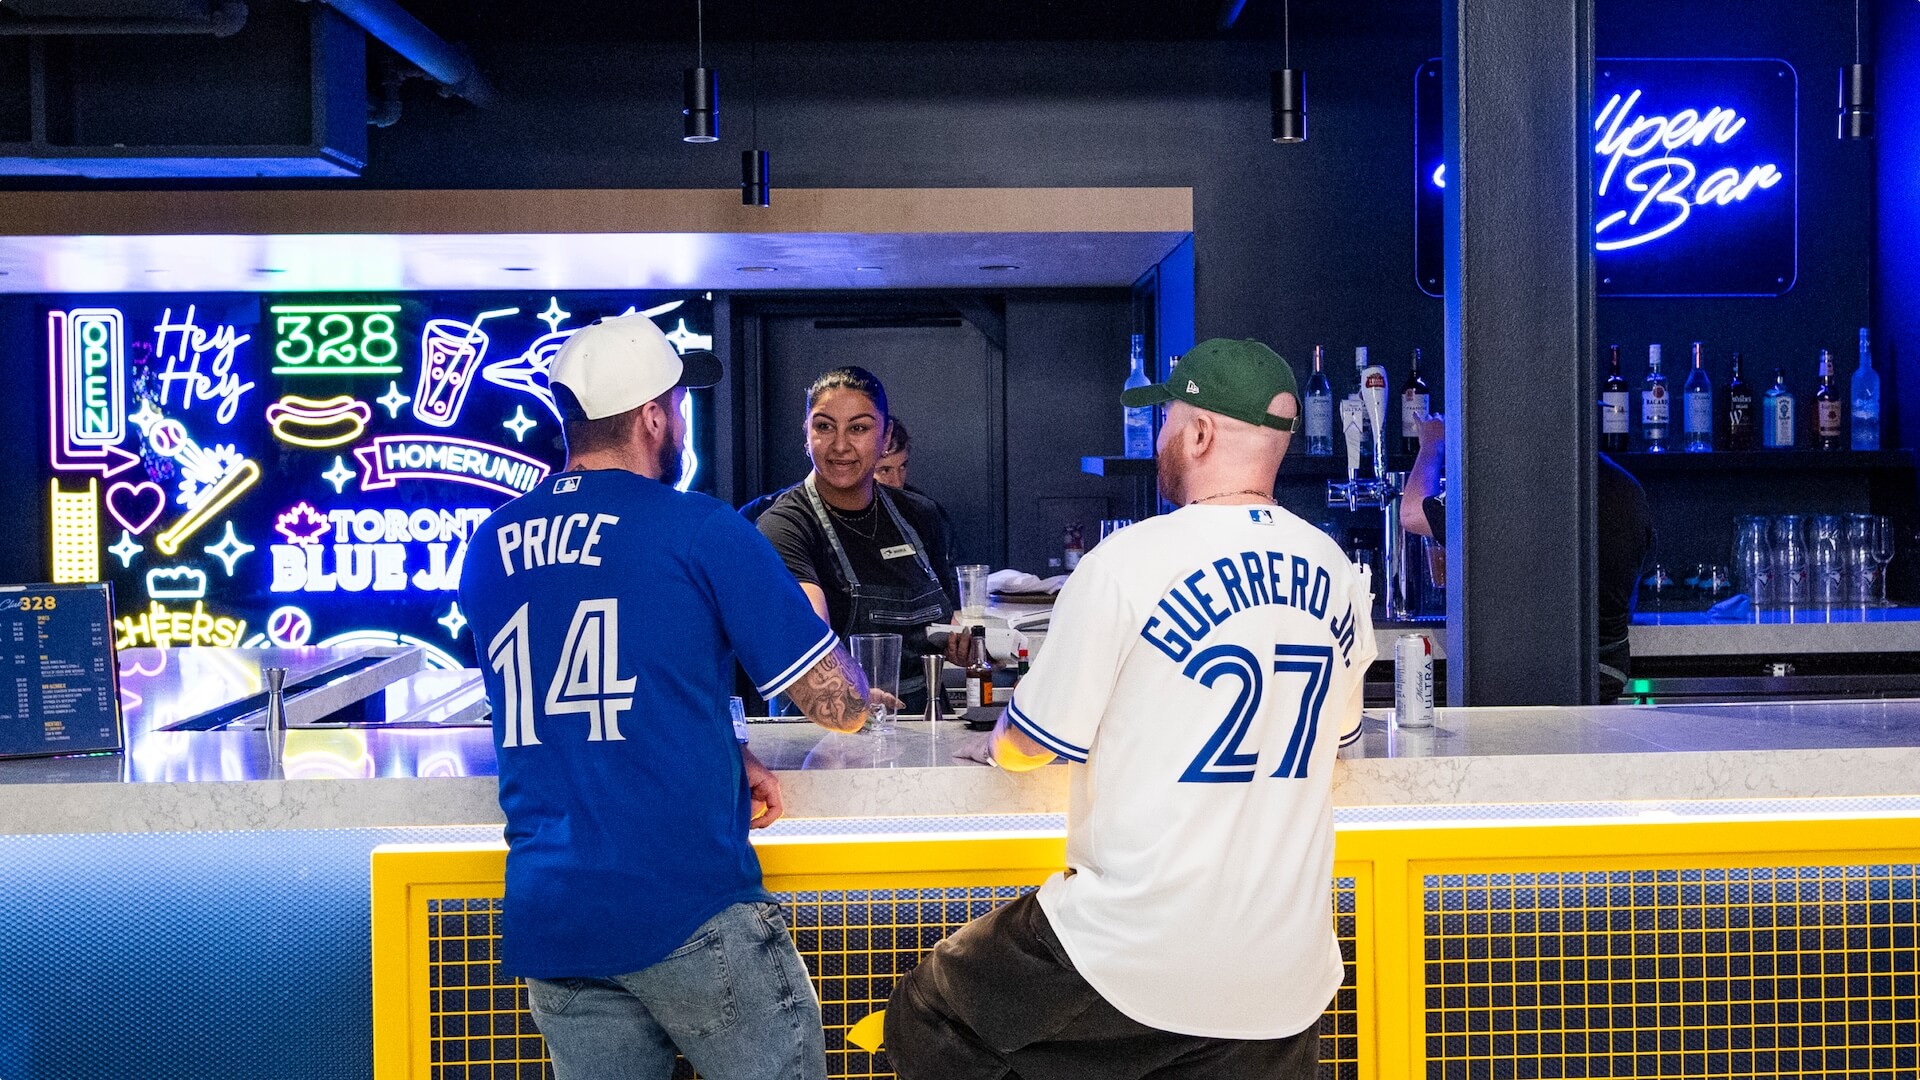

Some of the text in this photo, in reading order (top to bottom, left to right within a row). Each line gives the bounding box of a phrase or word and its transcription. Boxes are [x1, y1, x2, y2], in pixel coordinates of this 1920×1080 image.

[1596, 156, 1783, 251] Bar
[153, 304, 251, 377] Hey
[275, 313, 398, 365] 328
[82, 320, 109, 434] OPEN
[158, 352, 255, 425] Hey
[328, 507, 494, 543] TORONT
[496, 512, 621, 578] PRICE
[20, 595, 57, 611] 328
[269, 540, 469, 593] BLUE JA
[1140, 550, 1332, 663] GUERRERO
[487, 597, 639, 749] 14
[1424, 661, 1433, 710] ULTRA
[1176, 642, 1335, 784] 27
